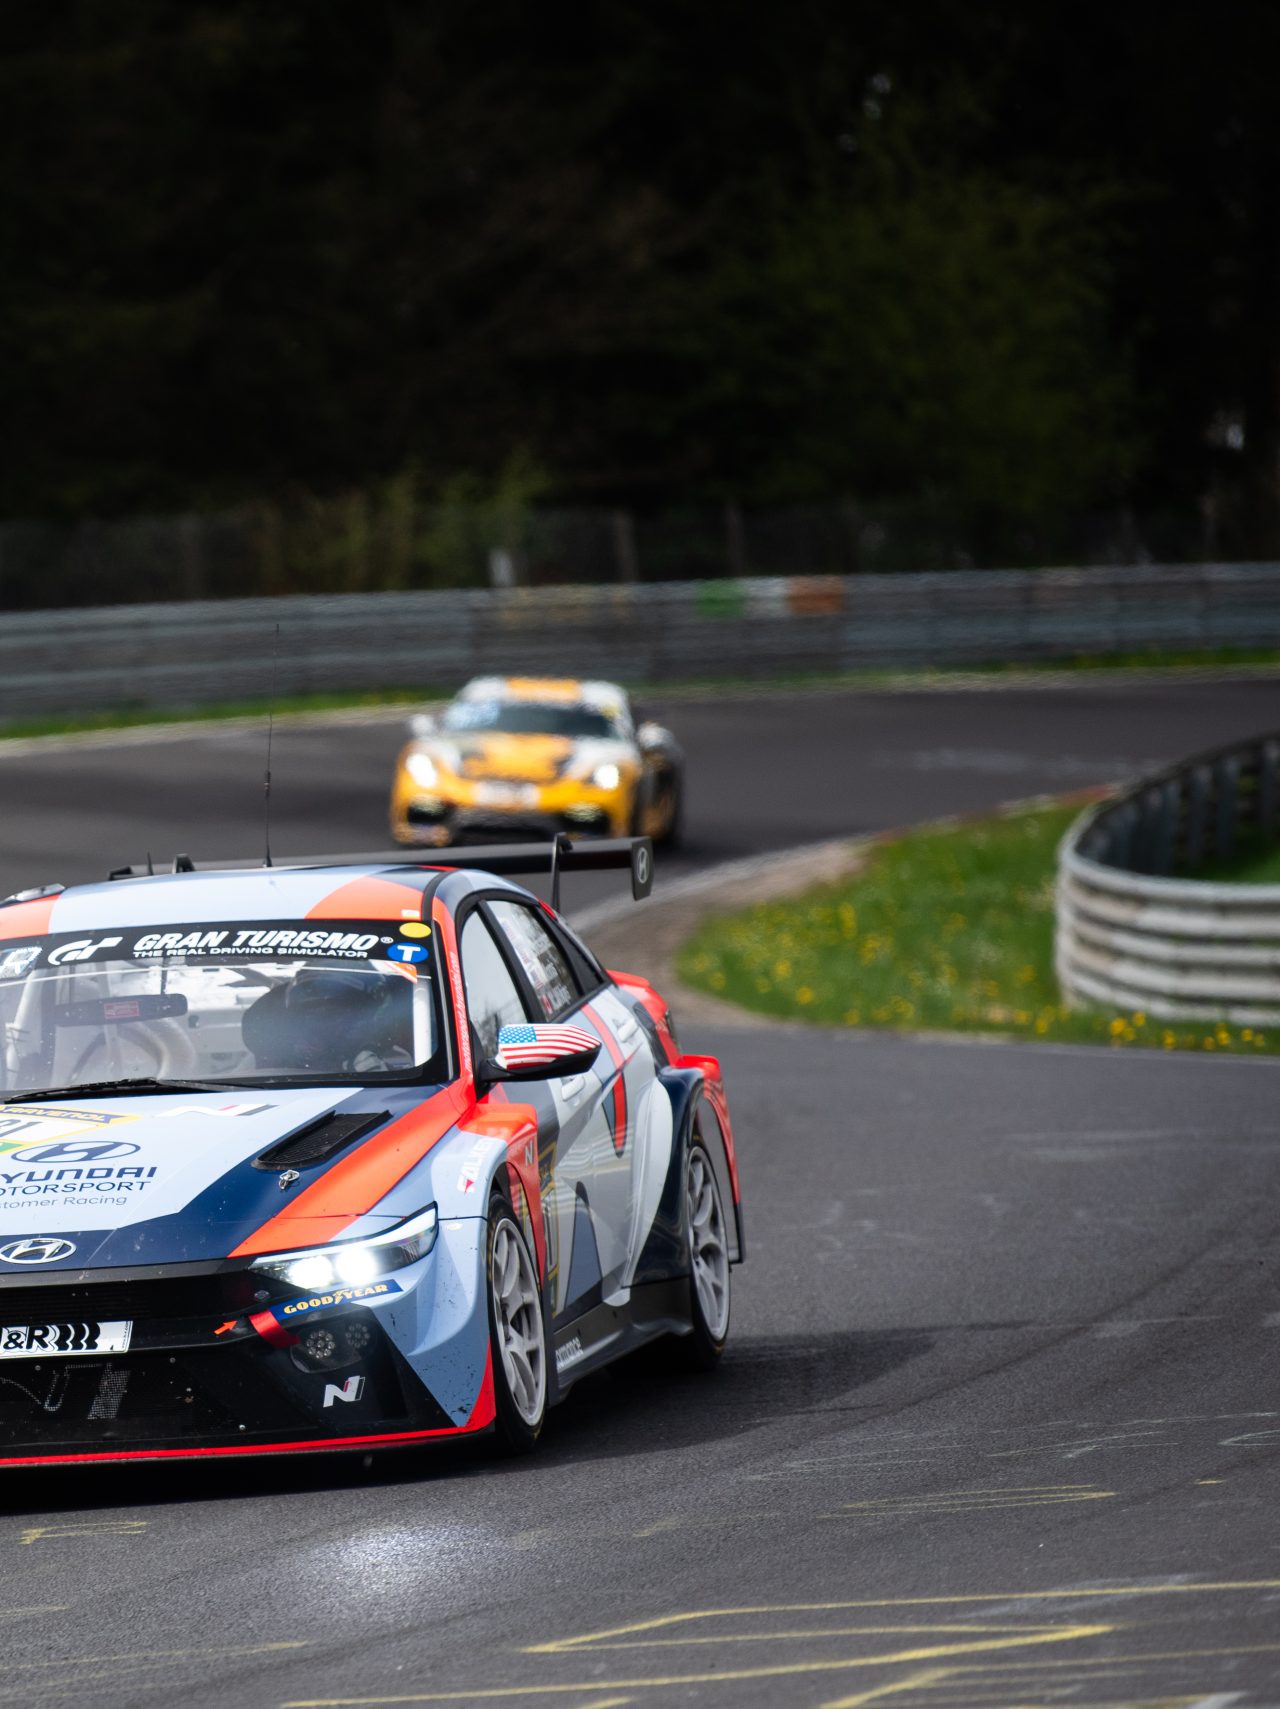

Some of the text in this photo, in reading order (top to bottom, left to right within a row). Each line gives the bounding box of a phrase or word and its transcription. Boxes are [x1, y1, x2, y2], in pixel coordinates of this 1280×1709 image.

[133, 930, 230, 951] GRAN
[132, 947, 369, 958] THE REAL DRIVING SIMULATOR
[397, 944, 421, 962] T
[1, 1105, 109, 1123] RAVENOL
[63, 1195, 128, 1206] Racing
[283, 1284, 389, 1315] GOODYEAR
